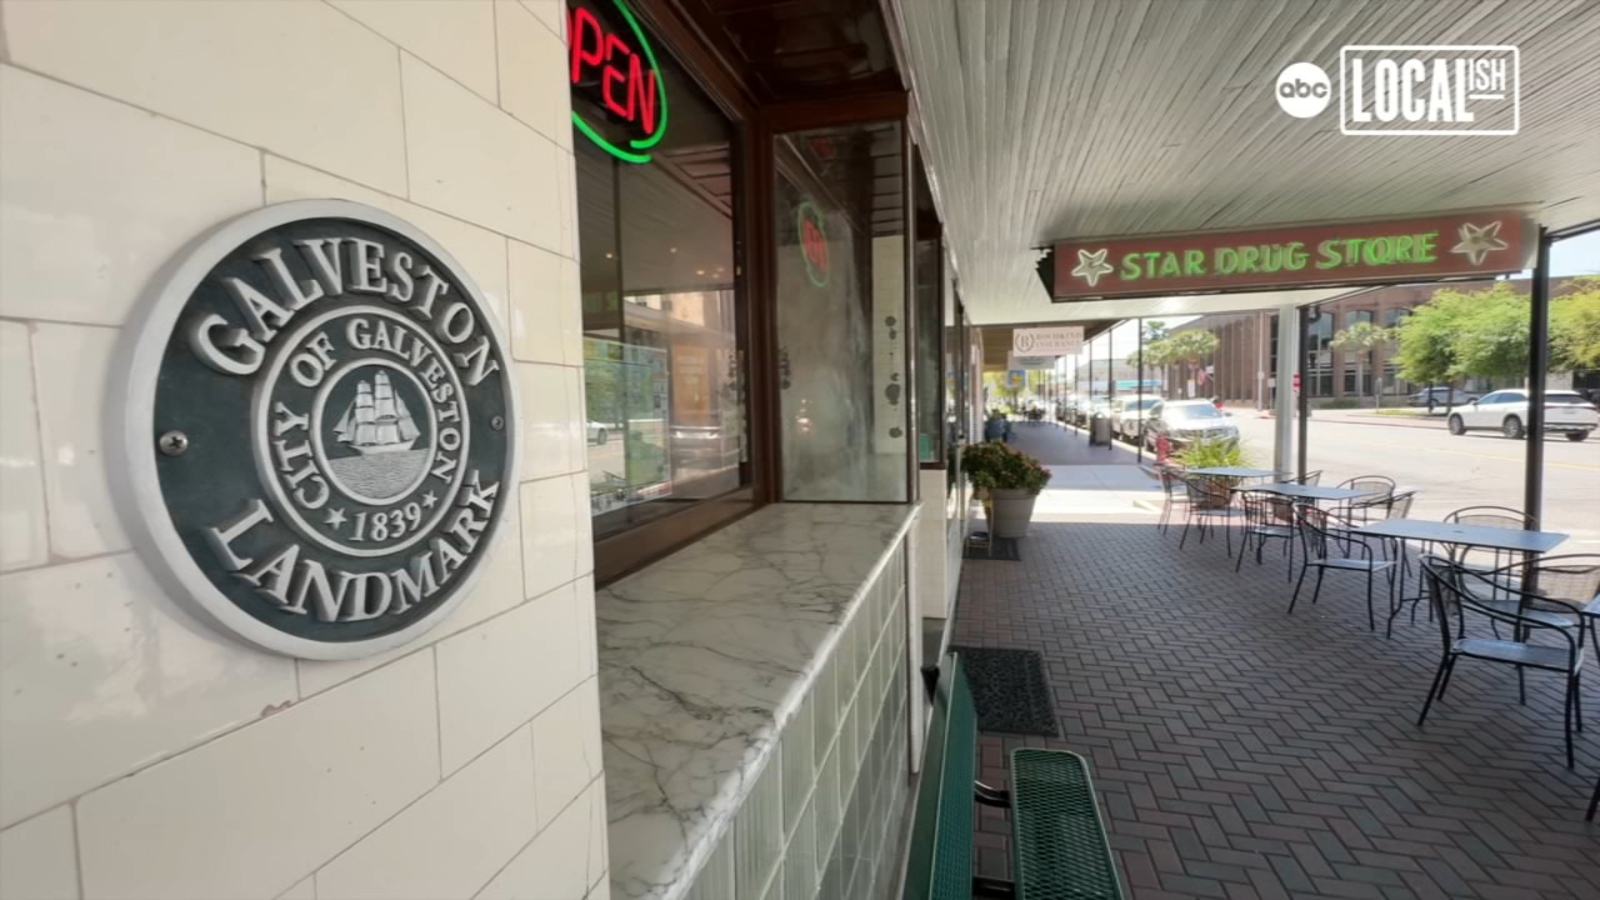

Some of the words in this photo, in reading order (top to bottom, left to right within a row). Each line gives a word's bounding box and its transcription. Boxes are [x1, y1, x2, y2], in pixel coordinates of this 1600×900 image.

[566, 6, 656, 135] PEN
[193, 236, 499, 387] GALVESTON
[1120, 249, 1207, 280] STAR
[1213, 241, 1310, 276] DRUG
[1314, 230, 1440, 270] STORE
[289, 331, 338, 388] OF
[346, 317, 461, 484] GALVESTON
[273, 401, 330, 510] CITY
[204, 469, 499, 623] LANDMARK
[348, 501, 422, 542] 1839
